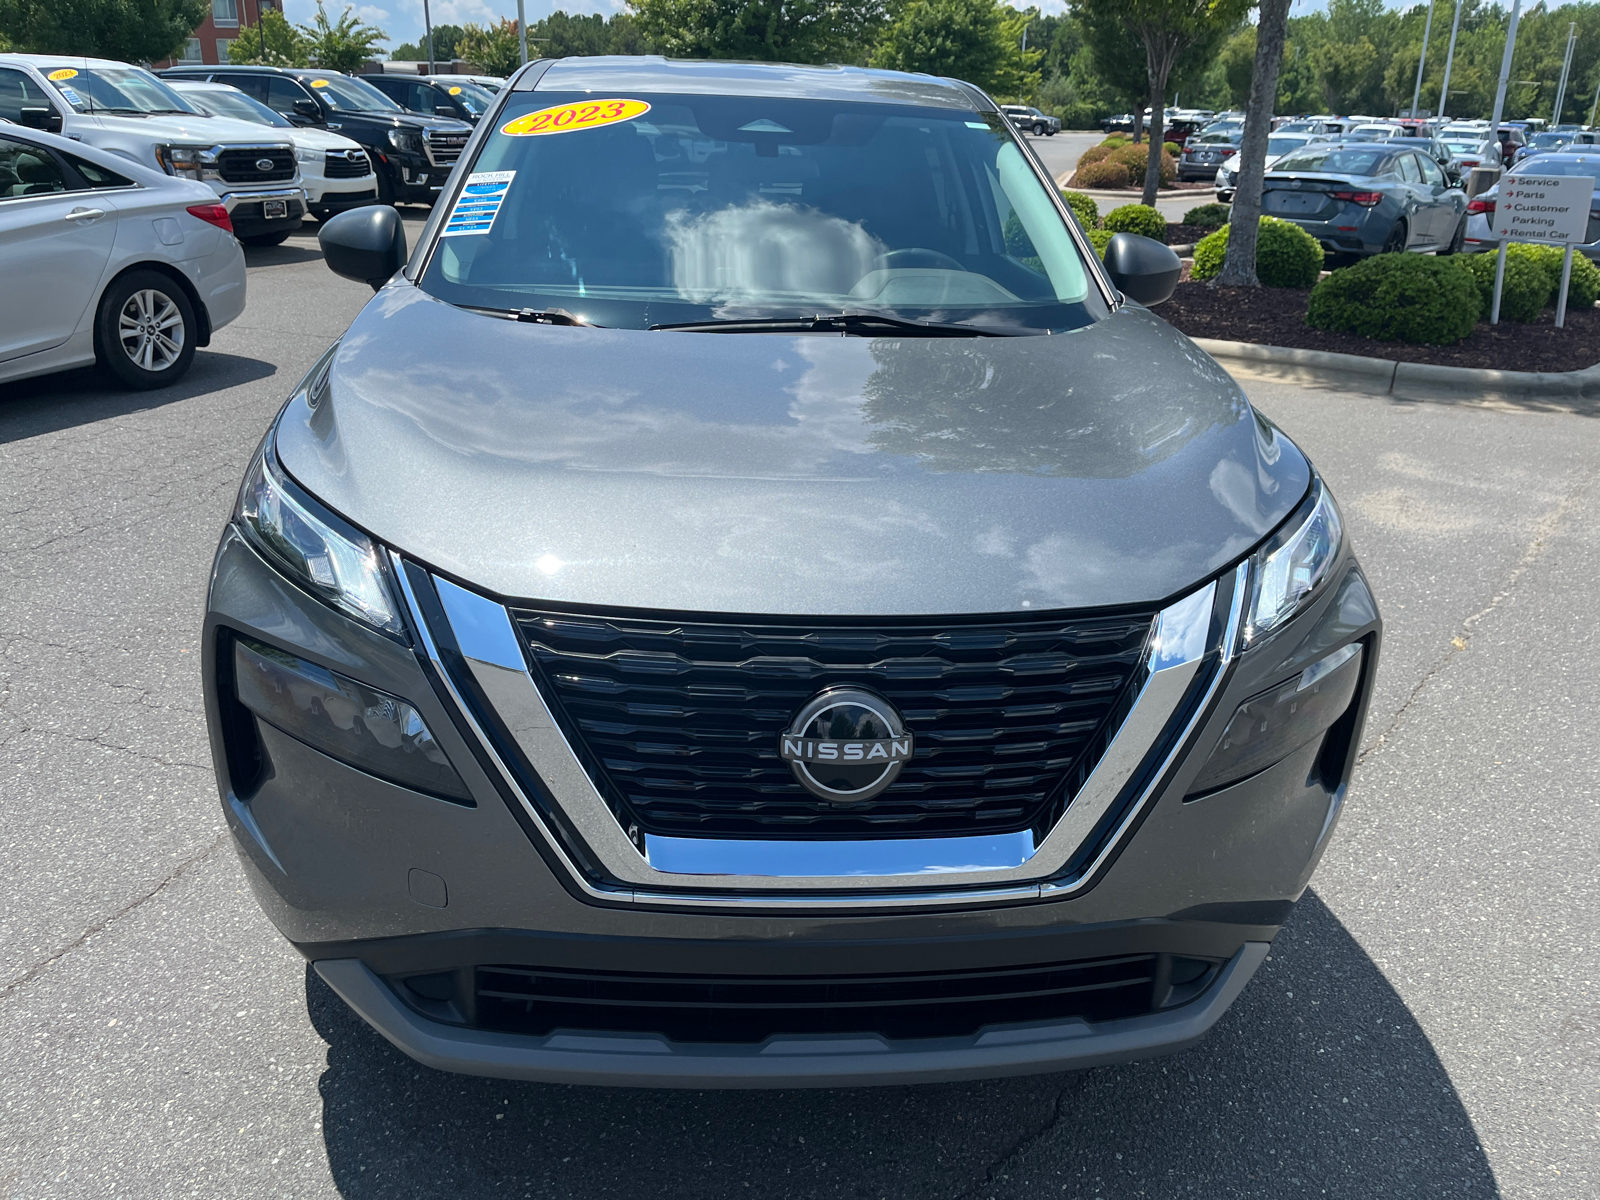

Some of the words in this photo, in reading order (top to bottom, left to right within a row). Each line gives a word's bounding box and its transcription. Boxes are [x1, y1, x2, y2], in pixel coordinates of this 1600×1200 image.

[527, 102, 626, 132] 2023
[1518, 177, 1560, 186] Service
[1516, 191, 1545, 199] Parts
[1514, 203, 1570, 213] Customer
[1512, 216, 1555, 227] Parking
[1510, 228, 1546, 238] Rental
[1550, 230, 1570, 239] Car
[784, 739, 909, 760] NISSAN
